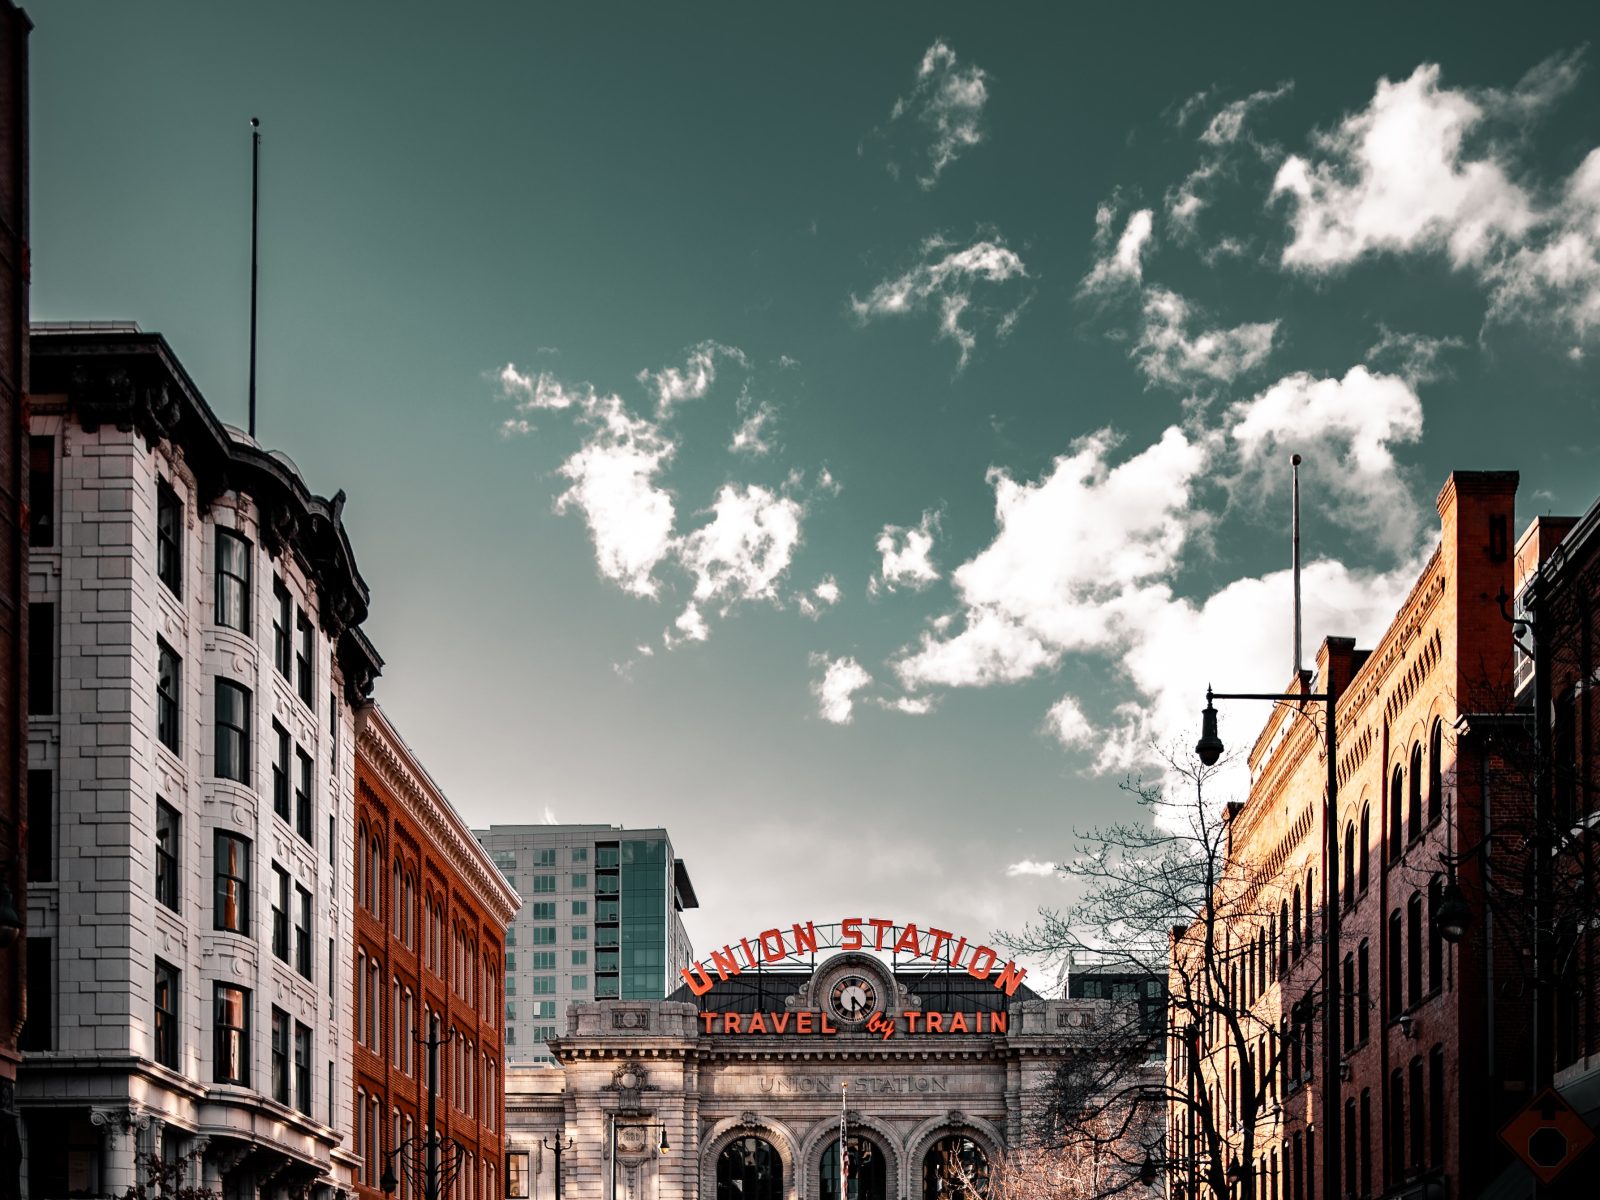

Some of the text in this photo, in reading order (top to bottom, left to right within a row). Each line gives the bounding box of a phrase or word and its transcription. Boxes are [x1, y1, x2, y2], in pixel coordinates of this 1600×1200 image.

[681, 918, 1027, 997] UNION STATION
[700, 1011, 1007, 1040] TRAVEL by TRAIN
[760, 1076, 948, 1093] UNION STATION
